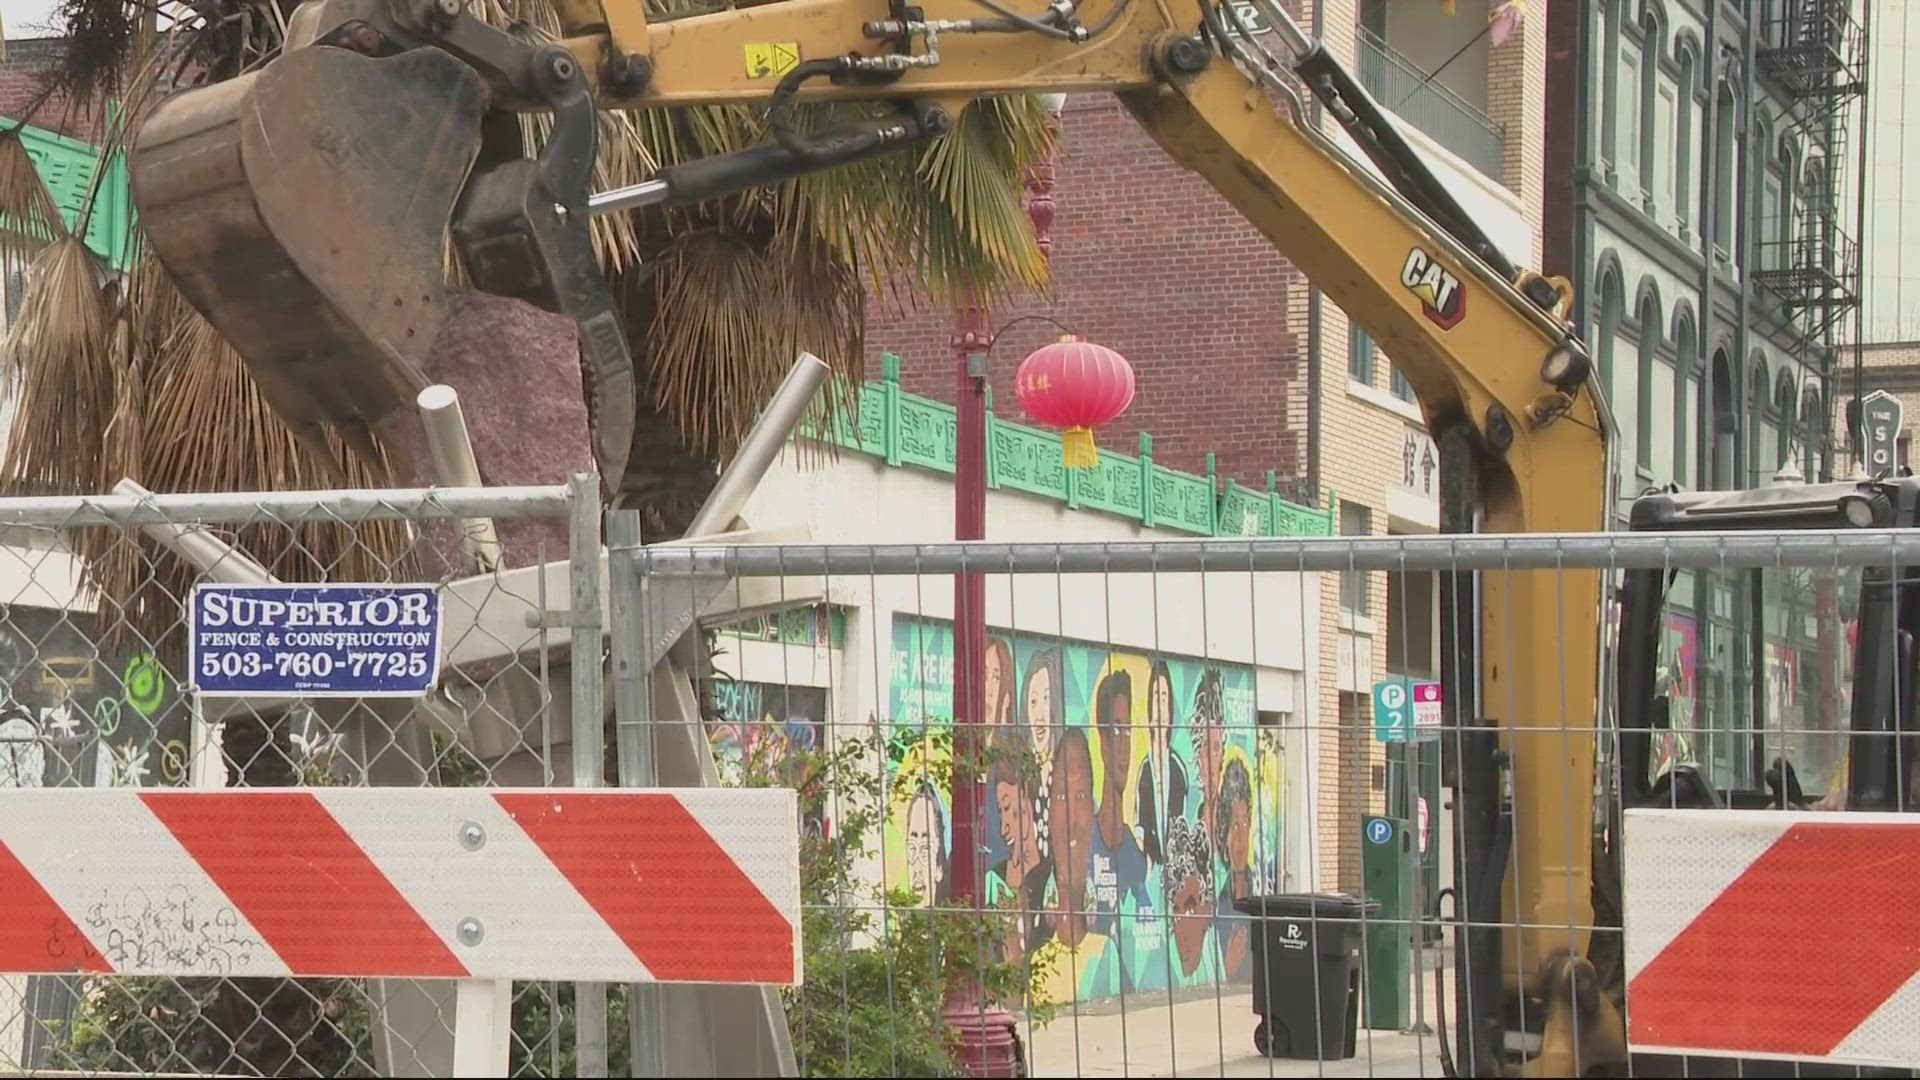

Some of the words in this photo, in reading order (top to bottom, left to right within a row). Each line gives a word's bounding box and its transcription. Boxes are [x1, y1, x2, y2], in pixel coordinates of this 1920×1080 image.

[1402, 247, 1460, 314] CAT
[202, 592, 432, 627] SUPERIOR
[200, 631, 261, 648] FENCE
[266, 632, 280, 647] &
[284, 631, 431, 649] CONSTRUCTION
[202, 651, 428, 678] 503-760-7725
[911, 653, 938, 685] ARE
[1389, 689, 1400, 705] P
[1387, 711, 1403, 733] 2
[1375, 823, 1386, 840] P
